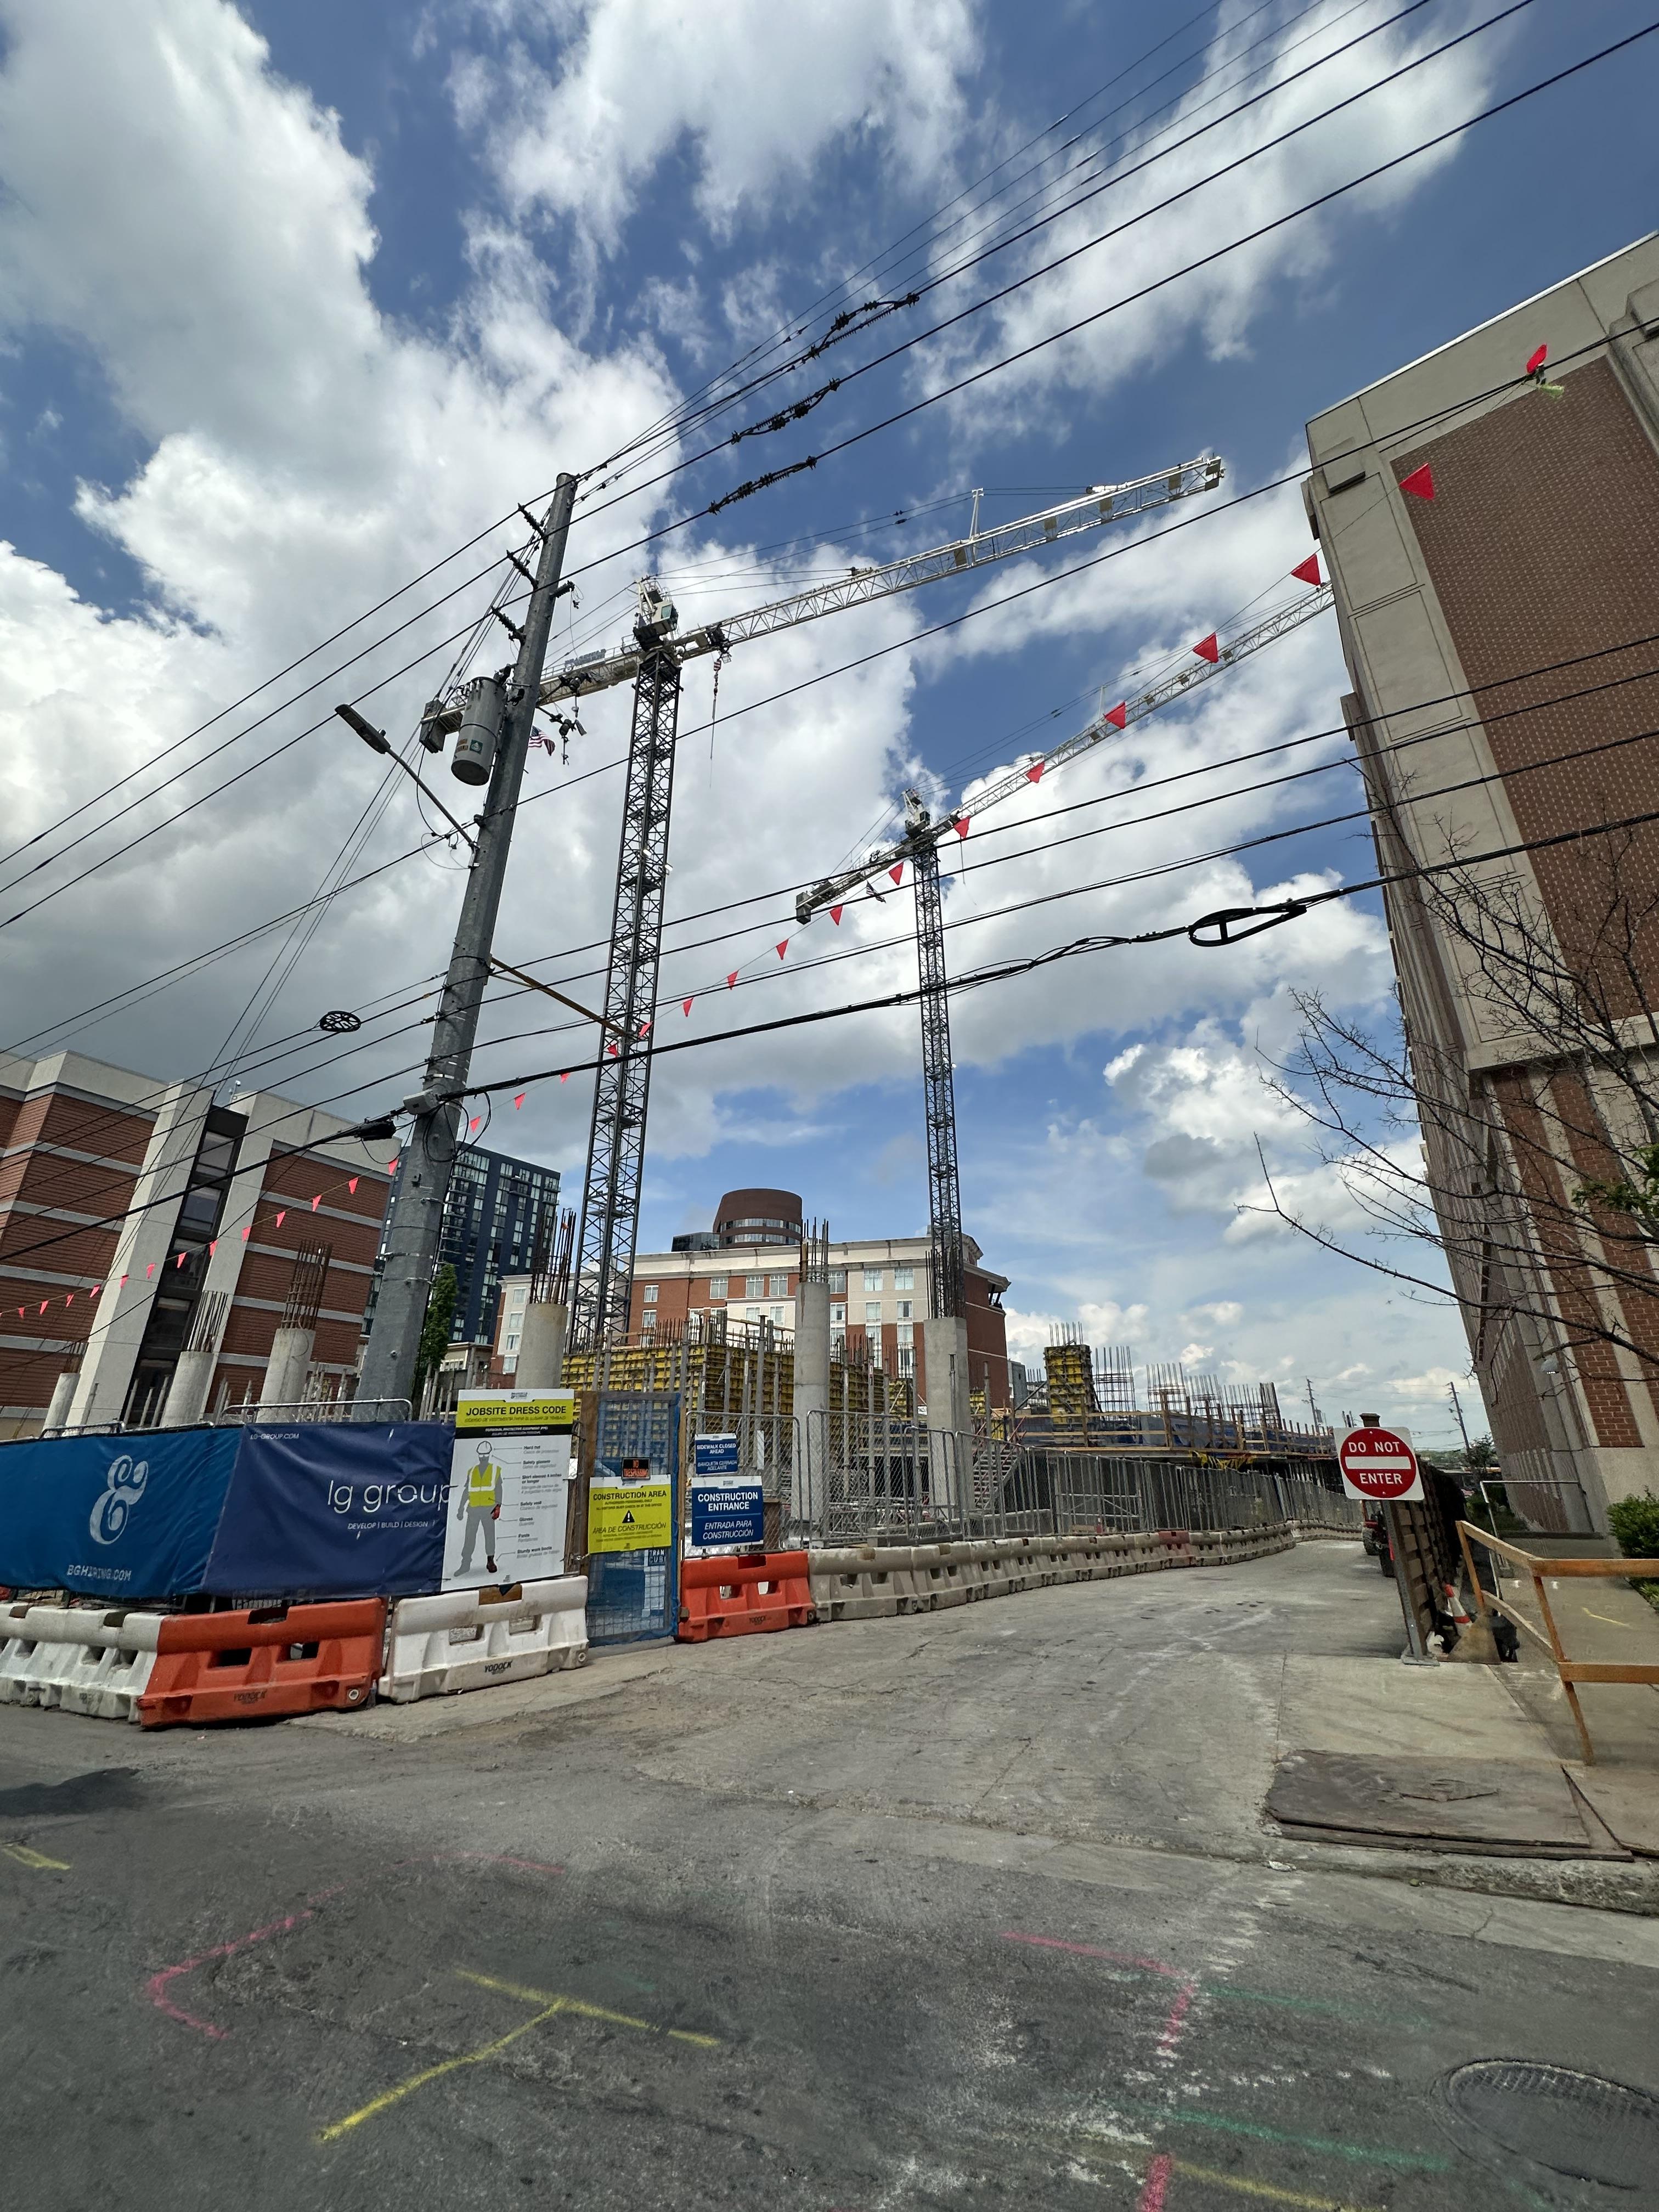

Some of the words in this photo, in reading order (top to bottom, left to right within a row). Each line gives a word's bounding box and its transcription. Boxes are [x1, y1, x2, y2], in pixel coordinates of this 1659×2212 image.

[466, 1407, 506, 1416] JOBSITE
[1348, 1442, 1367, 1453] DO
[1374, 1441, 1400, 1453] NOT
[1359, 1473, 1403, 1485] ENTER
[593, 1492, 646, 1501] CONSTRUCTION
[698, 1492, 758, 1502] CONSTRUCTION
[708, 1502, 749, 1511] ENTRANCE
[704, 1521, 735, 1530] ENTRADA
[736, 1520, 752, 1528] PARA
[703, 1528, 754, 1539] CONSTRUCCIÓN
[485, 1660, 513, 1673] YODOCK
